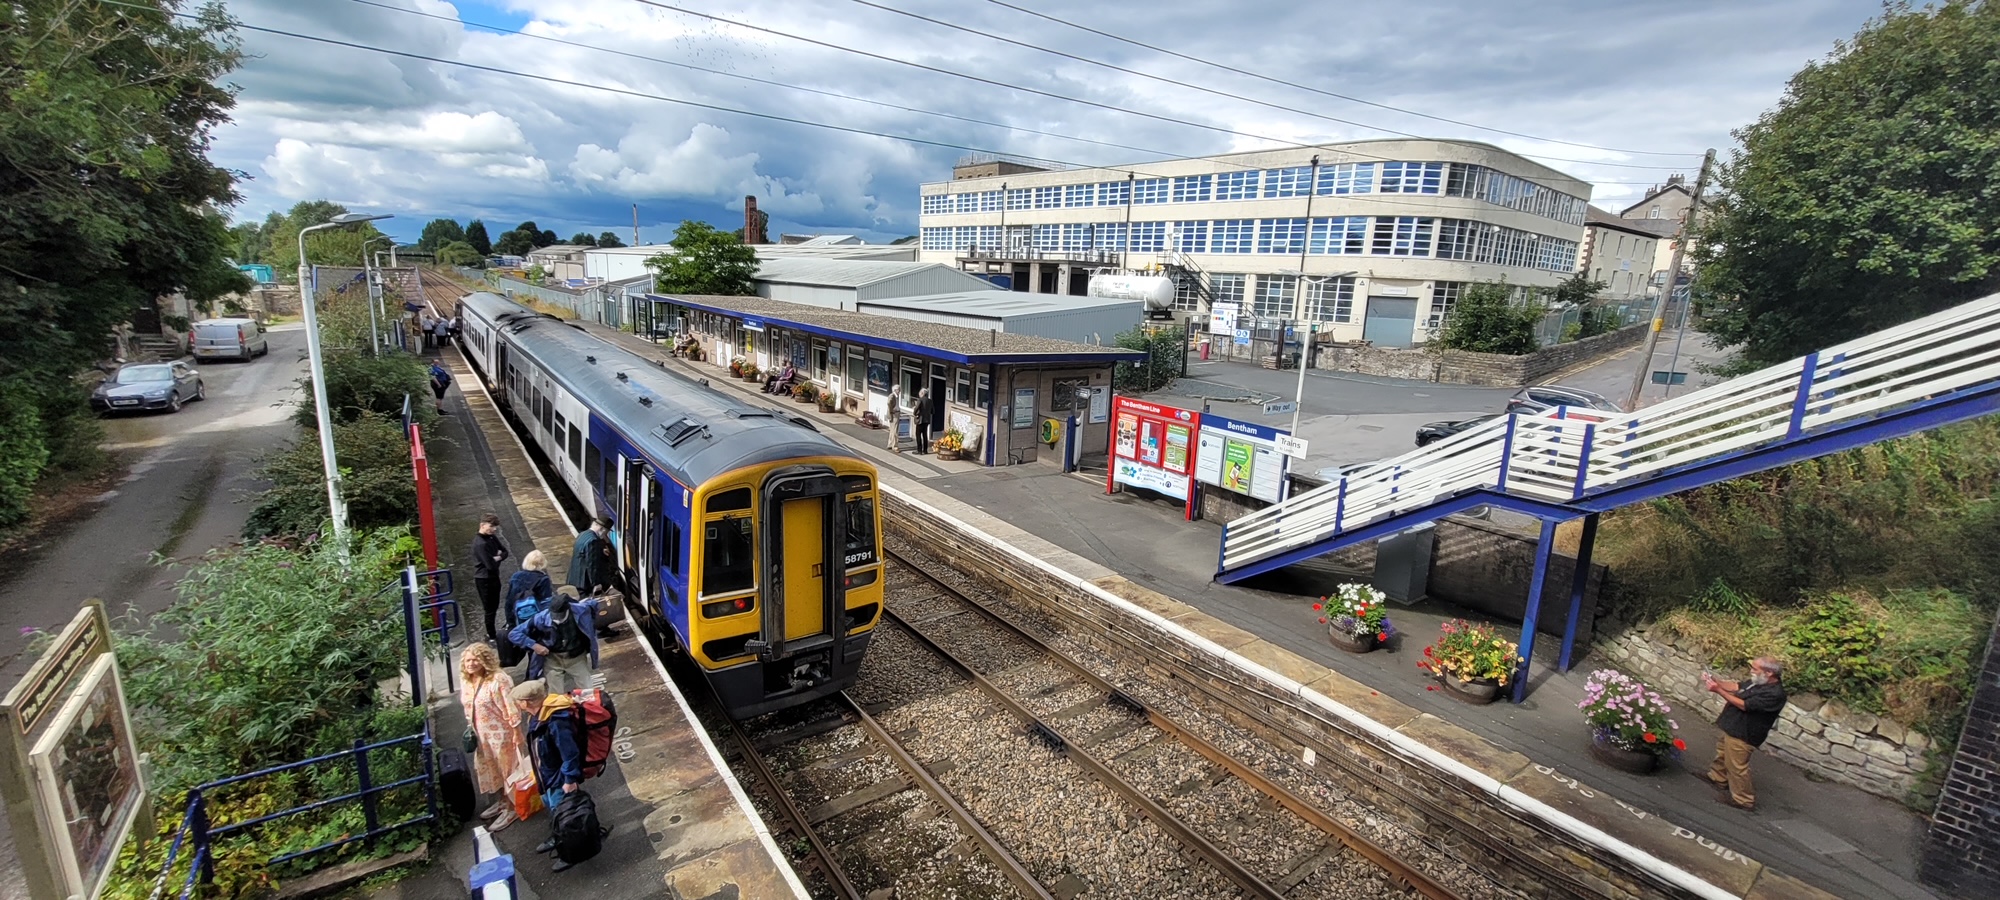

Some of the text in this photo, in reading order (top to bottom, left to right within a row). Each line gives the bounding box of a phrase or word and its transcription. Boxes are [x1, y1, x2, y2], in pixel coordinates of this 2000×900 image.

[1129, 402, 1150, 412] Bentham
[1149, 406, 1160, 414] Line
[1227, 421, 1258, 435] Bentham
[1281, 437, 1301, 449] Trains
[845, 550, 872, 564] 58791
[22, 703, 38, 723] The
